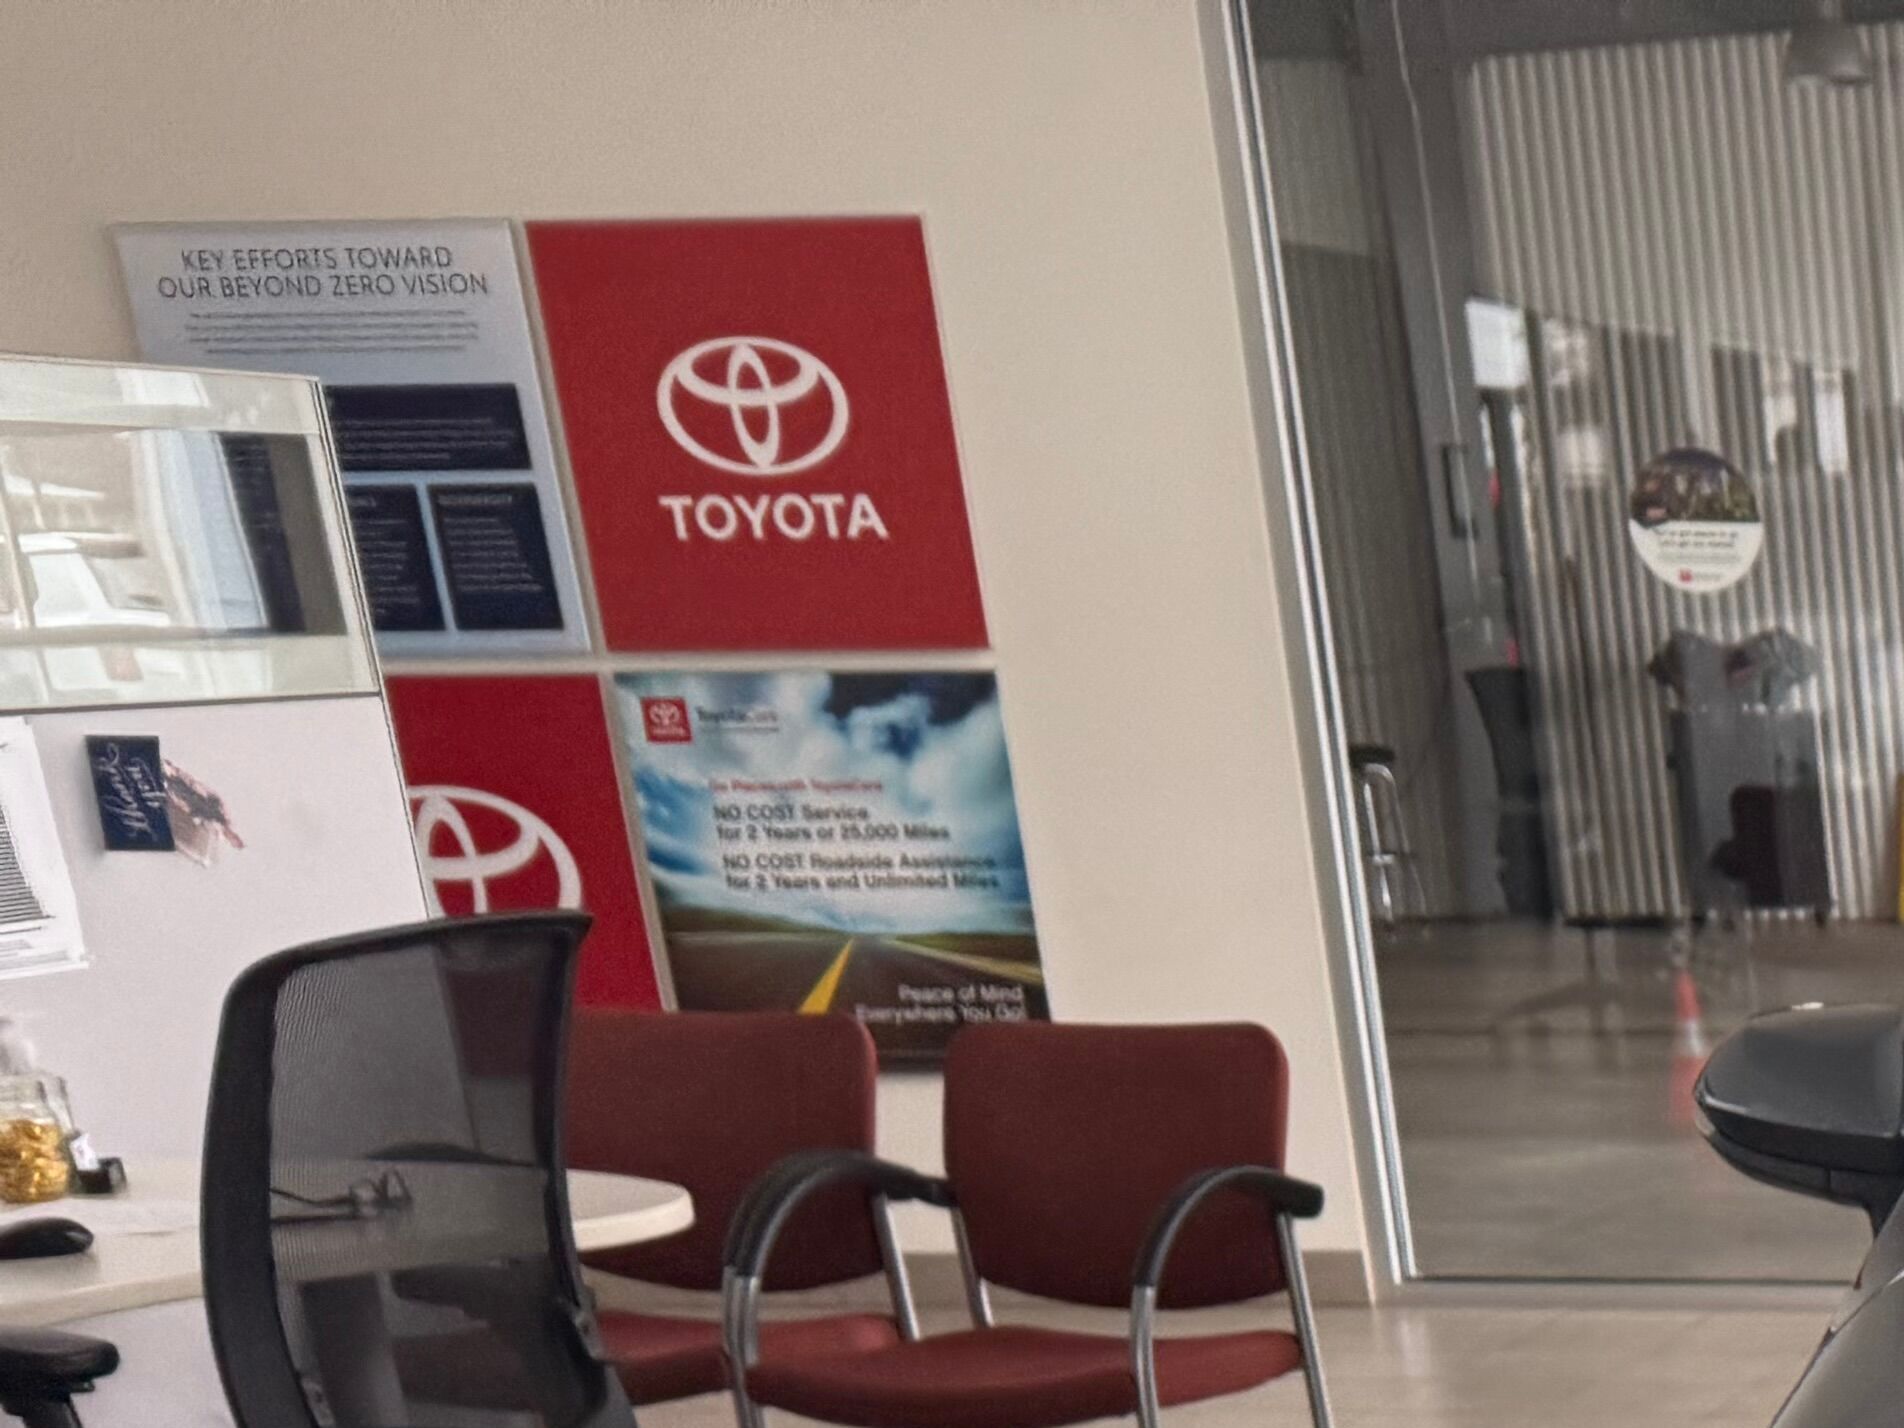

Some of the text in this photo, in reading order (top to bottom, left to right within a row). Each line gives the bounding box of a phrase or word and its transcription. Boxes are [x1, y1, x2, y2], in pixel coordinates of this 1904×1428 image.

[182, 246, 452, 271] KEY EFFORTS TOWARD
[158, 273, 489, 299] OUR BEYOND ZERO VISION
[658, 493, 890, 541] TOYOTA
[713, 803, 869, 821] NO COST Service
[716, 824, 741, 840] for
[748, 824, 759, 840] 2
[763, 824, 812, 840] Years
[816, 827, 834, 840] or
[903, 823, 950, 840] Miles
[723, 852, 997, 869] NO COST Roadside Assistance
[726, 872, 999, 889] for 2 Years and Unlimited Miles
[898, 983, 1024, 1002] Peace of Mind
